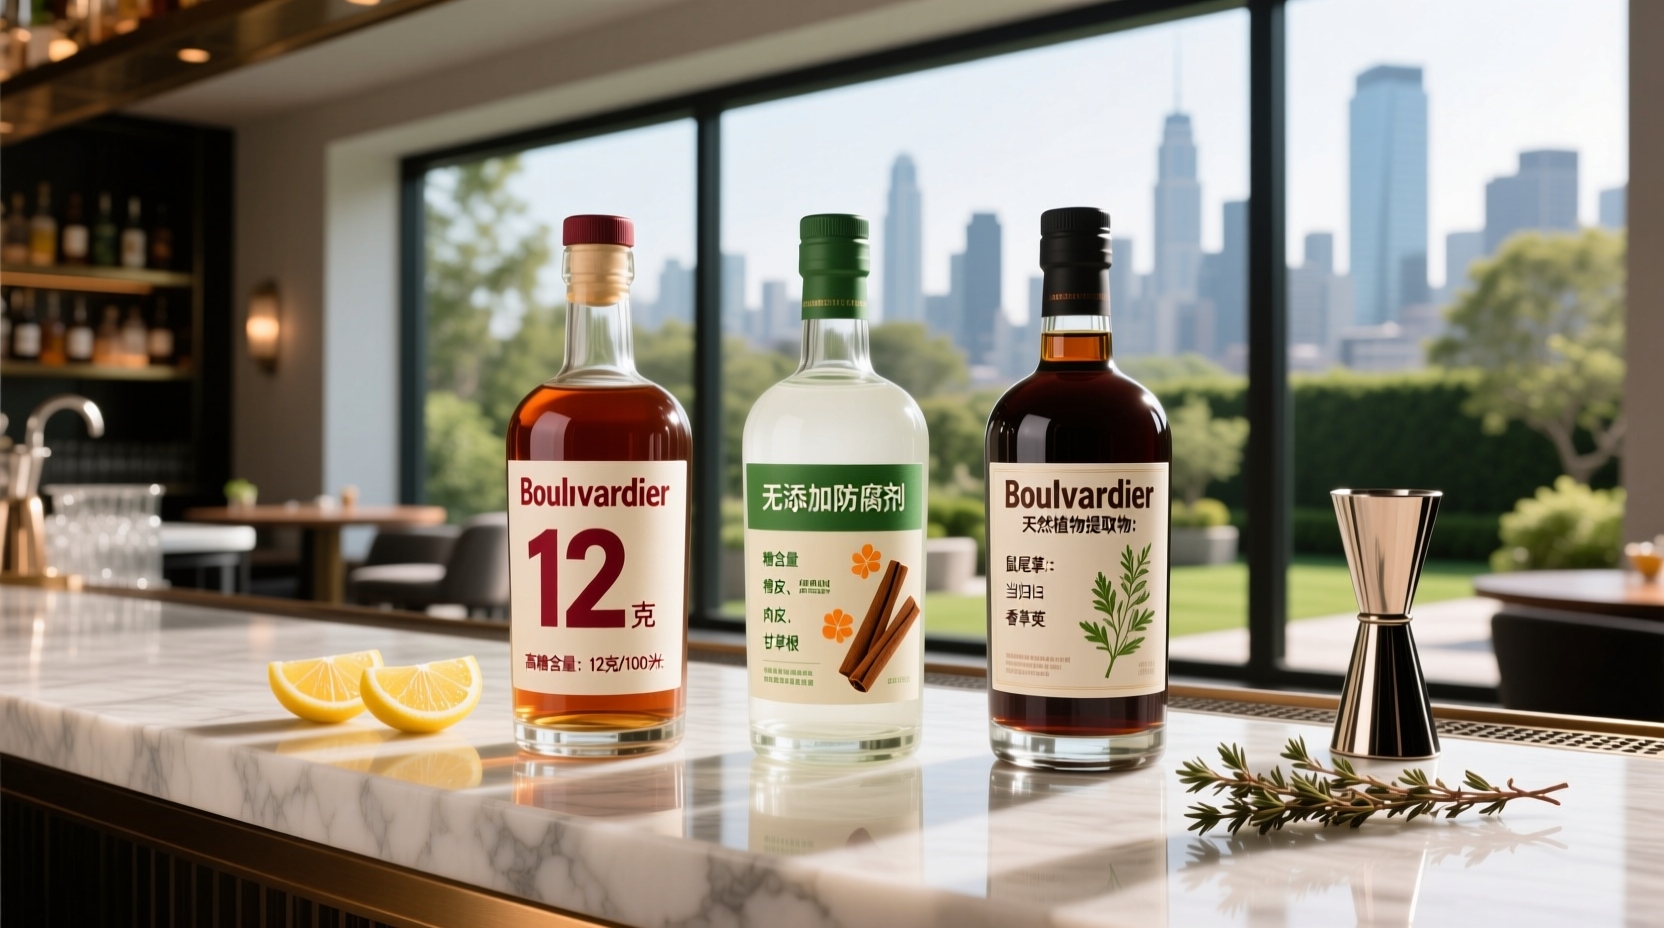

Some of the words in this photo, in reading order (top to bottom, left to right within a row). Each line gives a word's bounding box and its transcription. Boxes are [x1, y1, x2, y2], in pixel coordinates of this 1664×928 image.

[762, 482, 905, 513] 无添加防腐剂
[1005, 479, 1154, 509] Boulvardier
